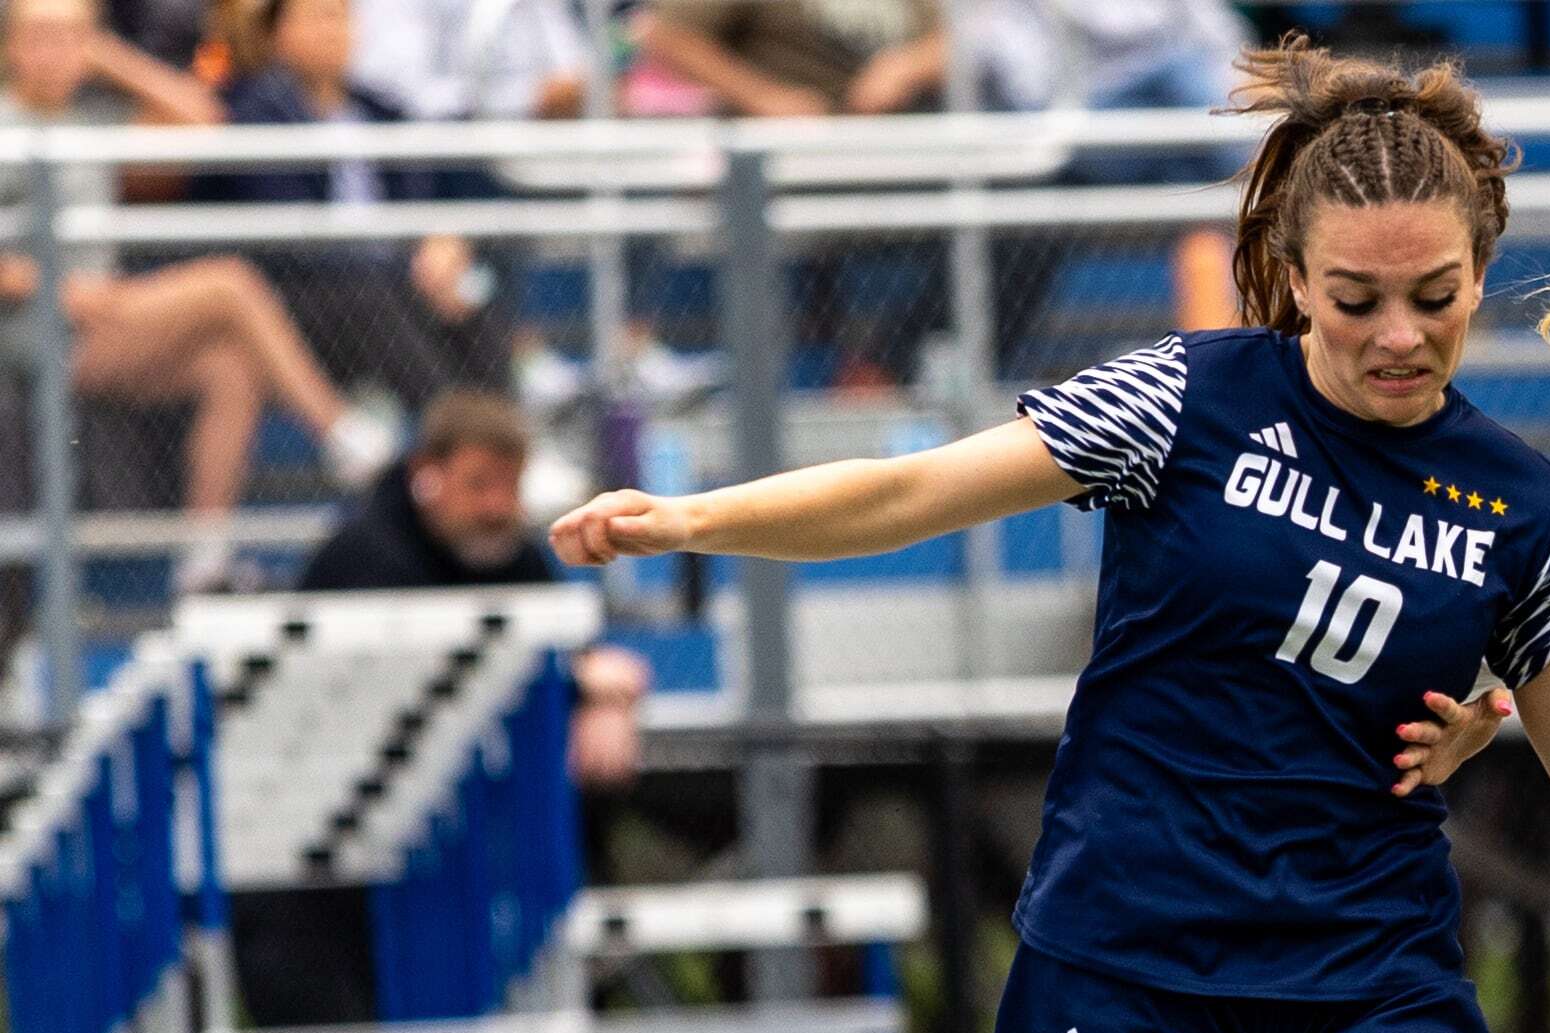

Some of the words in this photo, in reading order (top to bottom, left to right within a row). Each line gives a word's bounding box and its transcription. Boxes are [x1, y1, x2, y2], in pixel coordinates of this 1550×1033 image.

[1223, 452, 1348, 542] GULL
[1363, 501, 1496, 588] LAKE
[1274, 558, 1404, 685] 10
